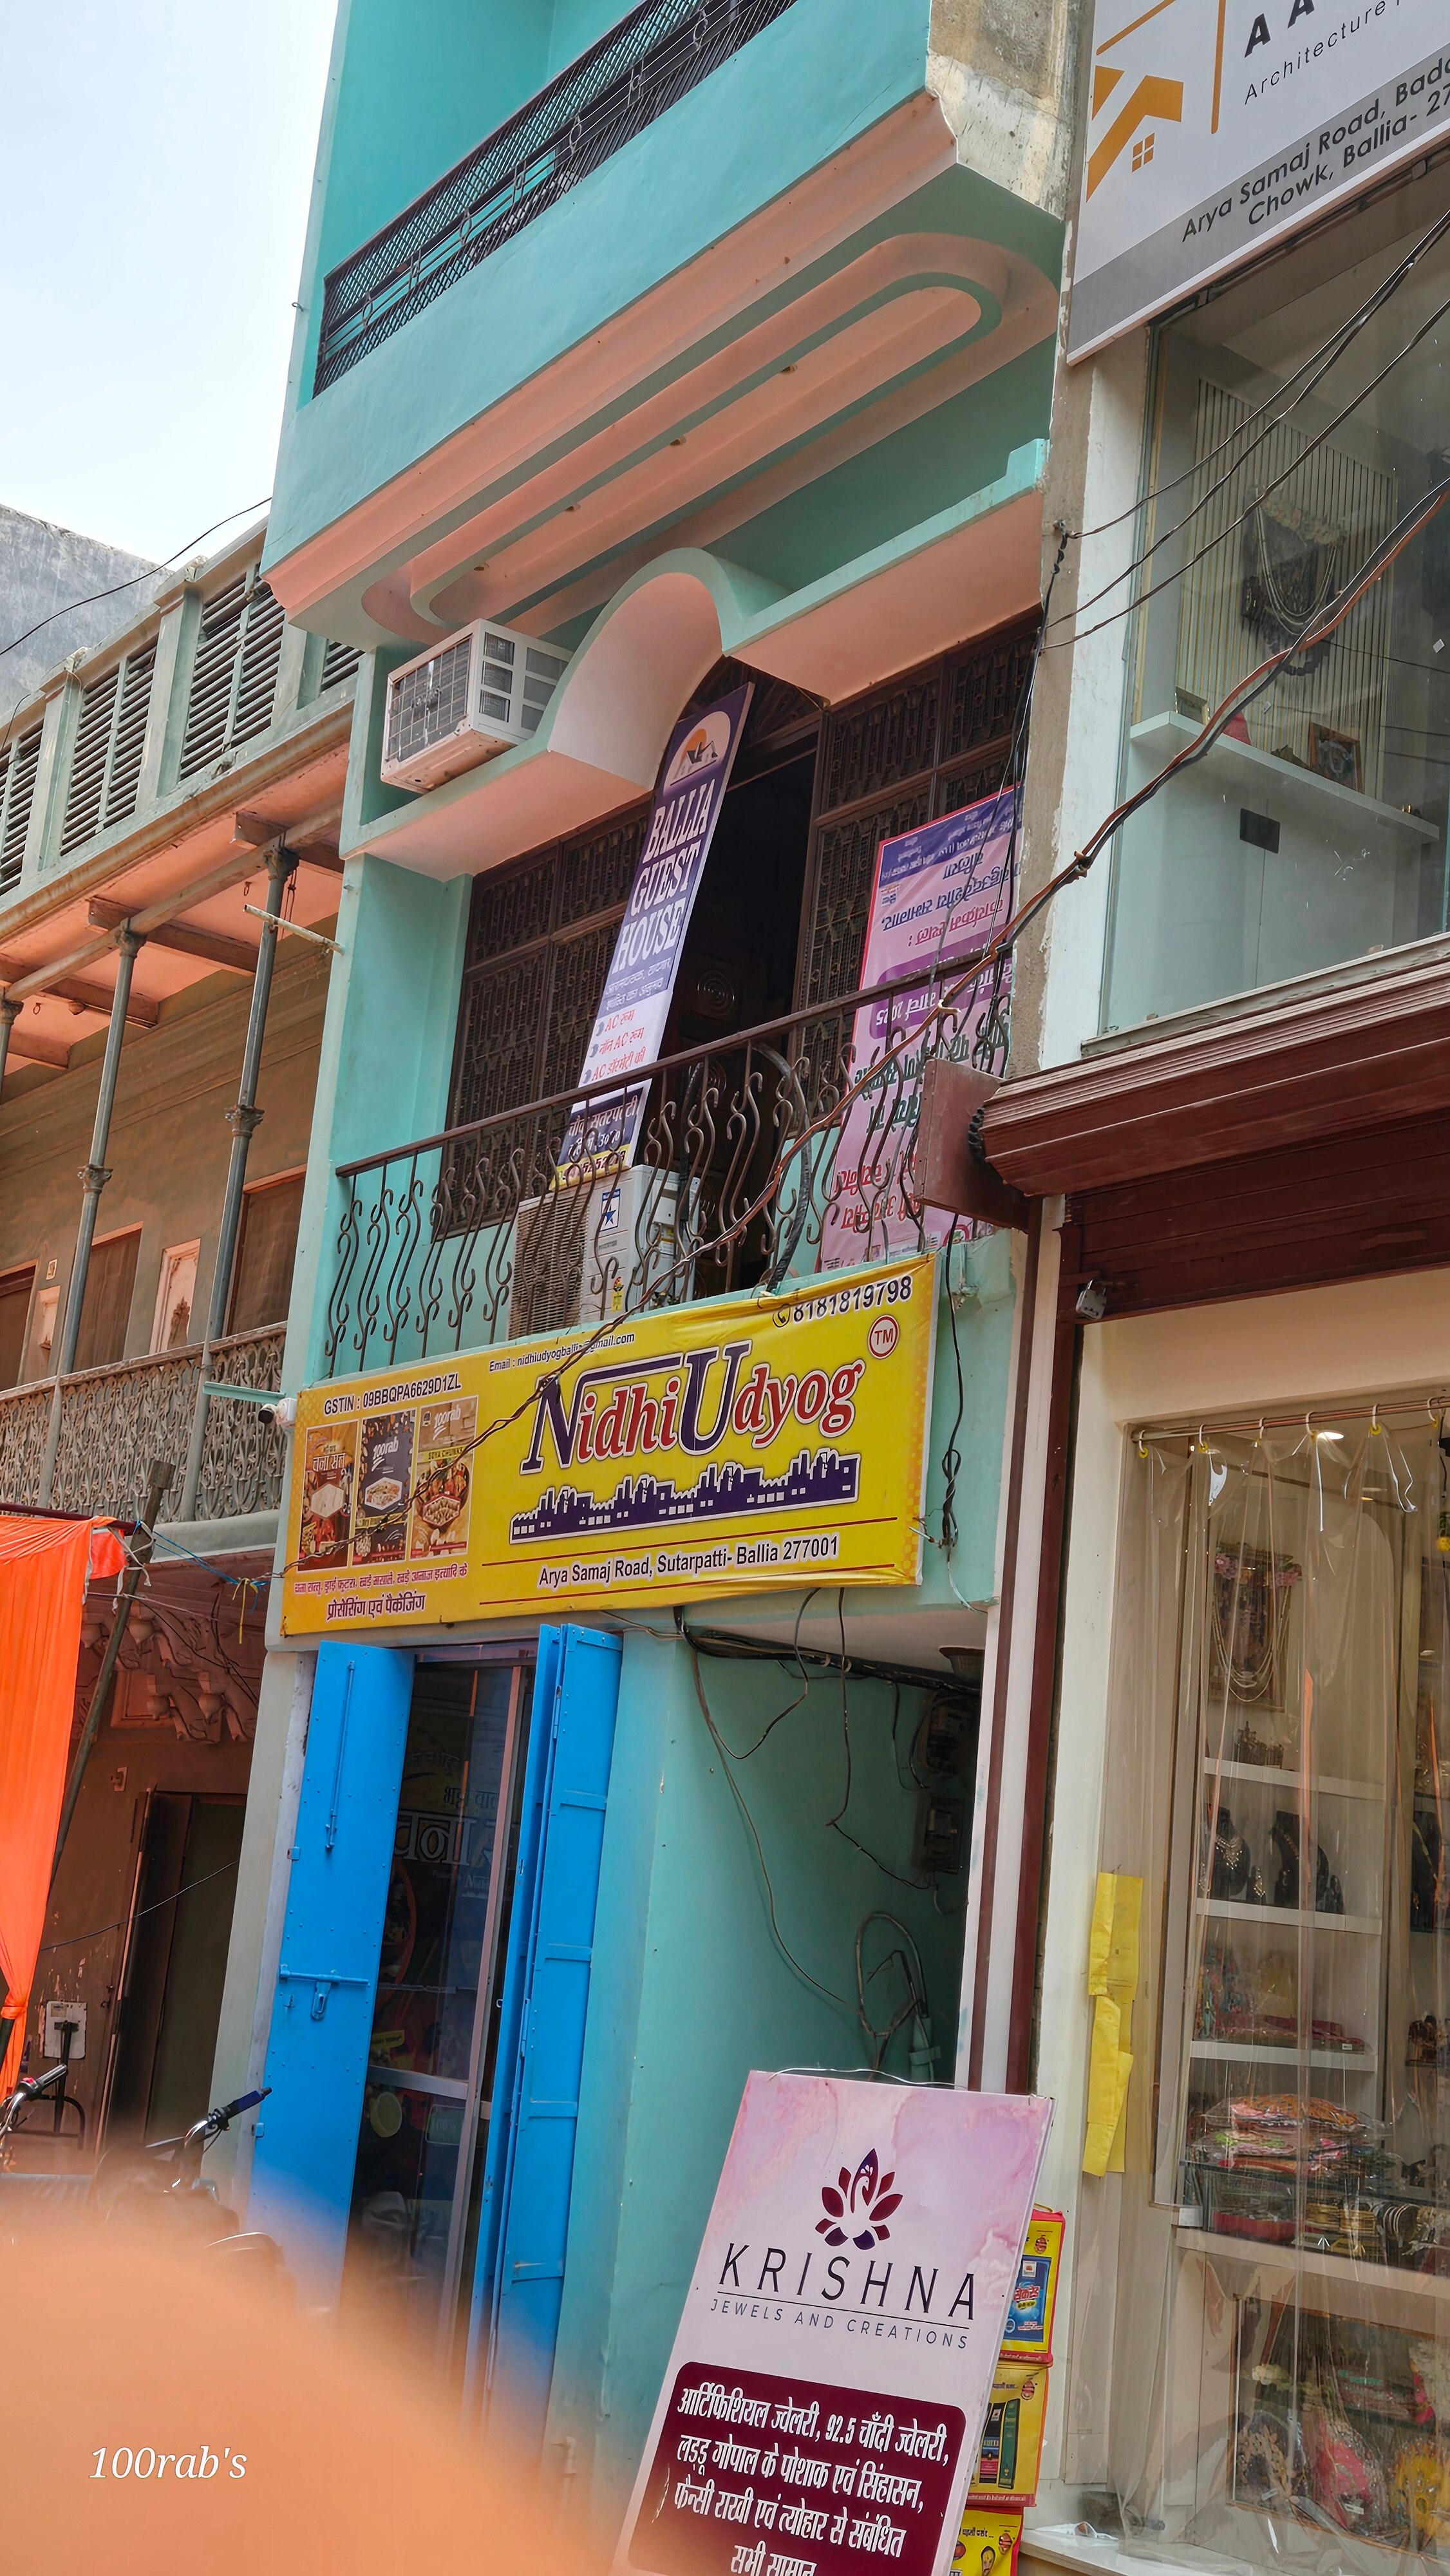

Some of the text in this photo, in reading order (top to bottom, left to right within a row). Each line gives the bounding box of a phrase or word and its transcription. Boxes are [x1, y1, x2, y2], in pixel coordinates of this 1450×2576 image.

[1245, 0, 1386, 105] Architecture
[1182, 201, 1232, 243] Arya
[1240, 143, 1310, 205] Samaj
[1319, 98, 1386, 155] Road,
[1248, 164, 1333, 225] Chowk,
[1343, 114, 1417, 168] Ballia-
[643, 779, 715, 864] BALLIA
[630, 839, 701, 917] GUEST
[611, 897, 686, 974] HOUSE
[948, 899, 1003, 933] कार्यक्रम
[605, 1014, 619, 1032] AC
[613, 1032, 628, 1050] AC
[591, 1063, 607, 1081] AC
[793, 1275, 912, 1323] 8181819798
[874, 1329, 894, 1346] TM
[489, 1358, 511, 1372] Email
[324, 1396, 355, 1416] GSTIN
[362, 1373, 462, 1408] 09BBQPA6629D1ZL
[539, 1535, 839, 1587] Arya Samaj Road, Sutarpatti- Ballia 277001
[719, 2242, 974, 2320] KRISHNA
[710, 2298, 968, 2349] JEWELS AND CREATIONS
[677, 2382, 950, 2467] आर्टिफिशियल ज्वेलरी, 92.5 चाँदी ज्वेलरी,
[711, 2433, 761, 2476] गोपाल
[760, 2442, 780, 2479] के
[780, 2446, 832, 2489] पोशाक
[832, 2458, 860, 2496] एवं
[857, 2460, 923, 2514] सिंहासन,
[715, 2486, 754, 2524] राखी
[754, 2493, 782, 2530] एवं
[778, 2497, 829, 2541] त्योहार
[829, 2506, 849, 2545] से
[849, 2511, 907, 2558] संबंधित
[731, 2540, 766, 2576] सभी
